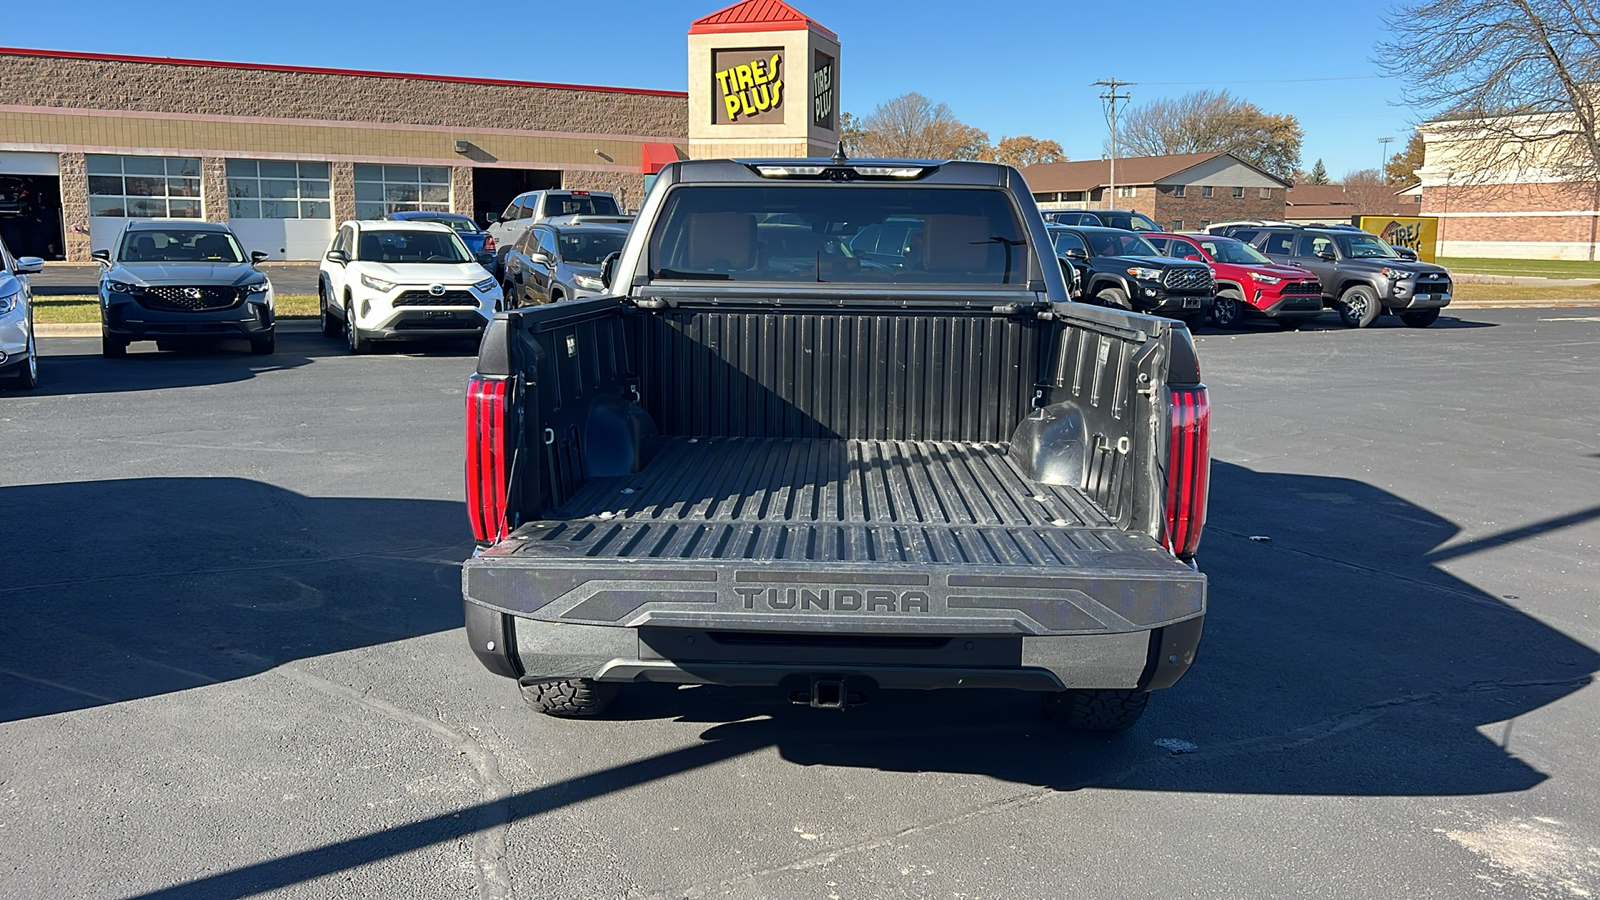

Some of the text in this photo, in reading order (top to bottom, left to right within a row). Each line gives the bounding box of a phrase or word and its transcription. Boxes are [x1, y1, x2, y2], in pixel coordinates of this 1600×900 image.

[715, 53, 781, 96] TIRES
[813, 65, 831, 97] TIRES
[724, 79, 784, 121] PLUS
[815, 88, 832, 122] PLUS
[1388, 222, 1421, 248] TIRES
[733, 587, 930, 613] TUNDRA
